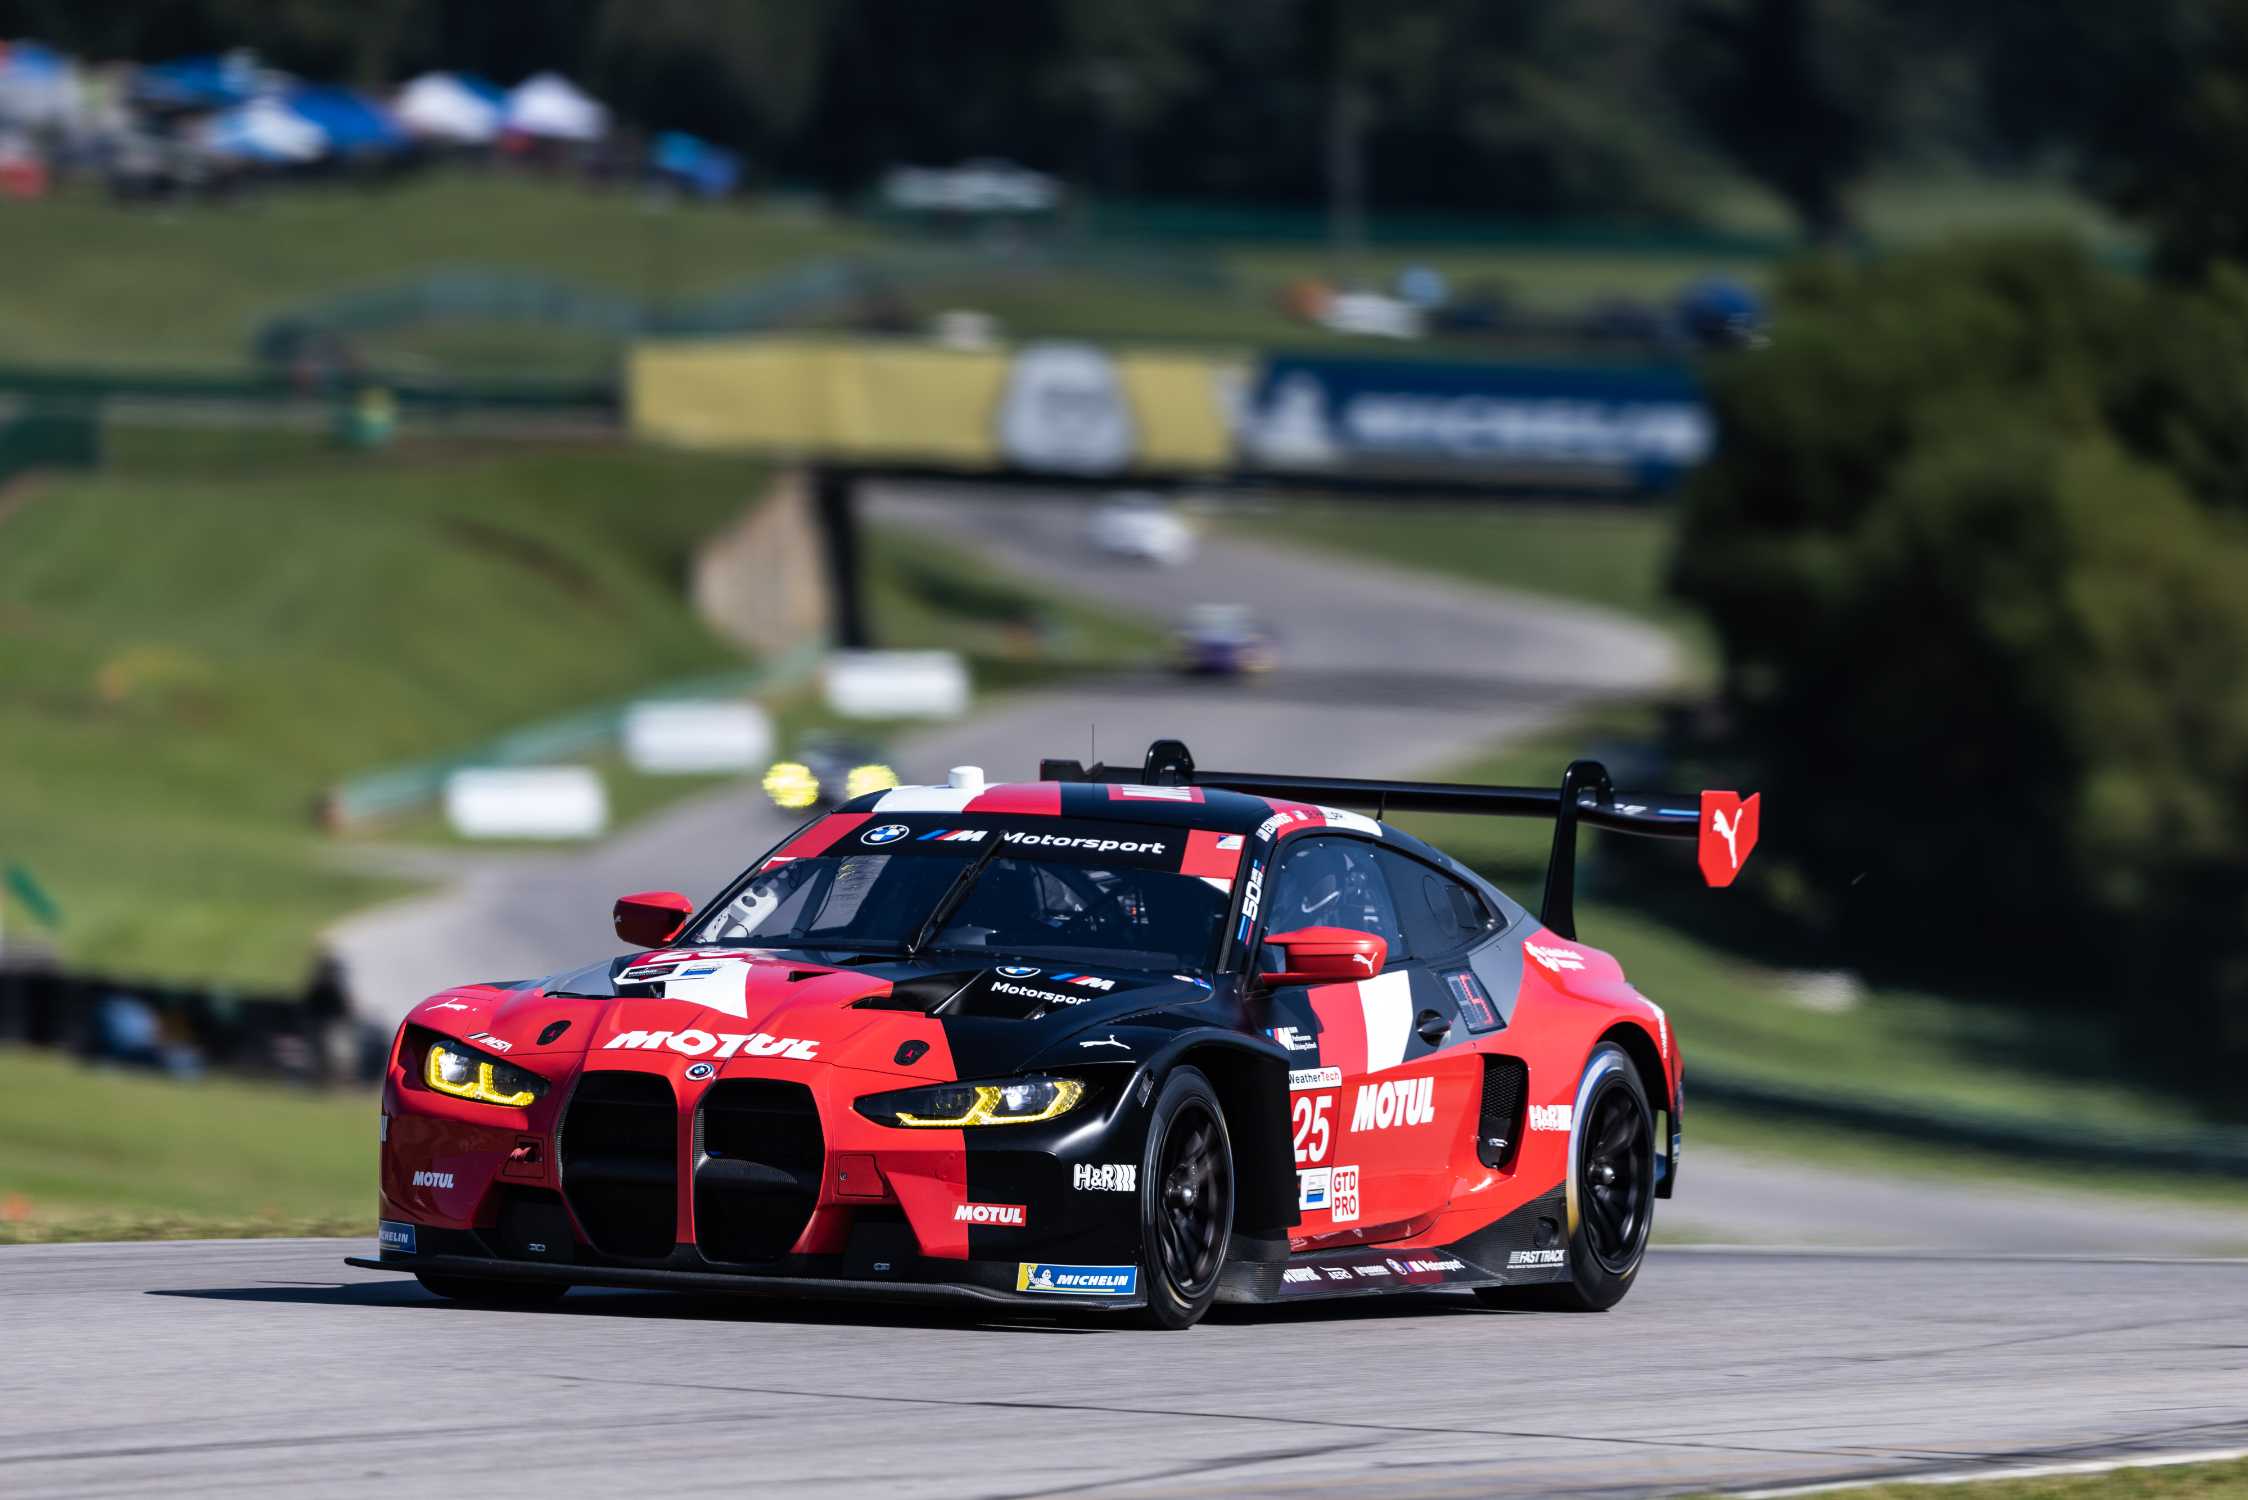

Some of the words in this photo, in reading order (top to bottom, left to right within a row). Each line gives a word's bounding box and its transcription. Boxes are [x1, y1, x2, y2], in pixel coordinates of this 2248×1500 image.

[1002, 830, 1165, 855] Motorsport
[1242, 880, 1262, 922] 50
[990, 981, 1092, 1005] Motorspor
[603, 1029, 821, 1061] MOTUL
[1289, 1071, 1340, 1085] WeatherTech
[1350, 1076, 1435, 1132] MOTUL
[1292, 1095, 1333, 1163] 25
[412, 1170, 455, 1189] MOTUL
[1074, 1163, 1116, 1191] H&R
[1333, 1171, 1356, 1193] GTD
[954, 1205, 1023, 1224] MOTUL
[1334, 1196, 1357, 1217] PRO
[379, 1229, 409, 1244] CHELIN
[1056, 1274, 1129, 1287] MICHELIN
